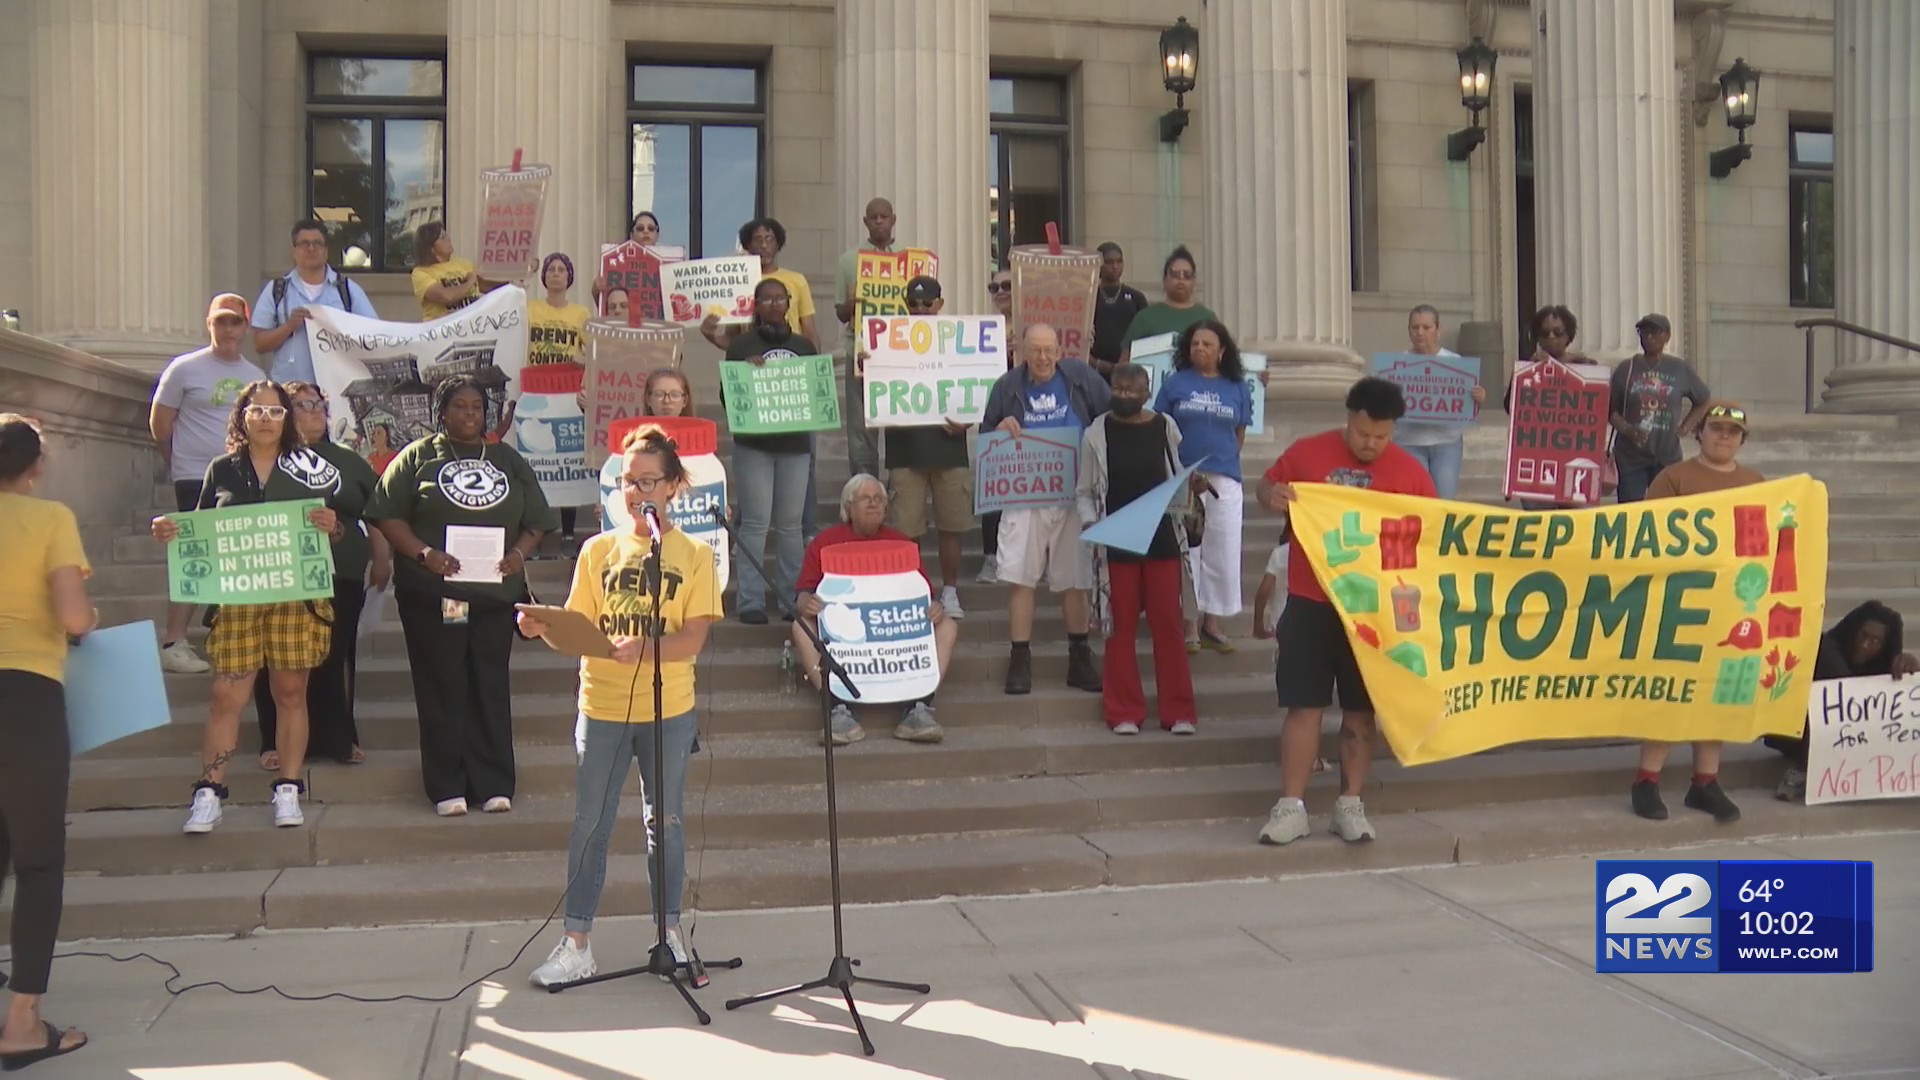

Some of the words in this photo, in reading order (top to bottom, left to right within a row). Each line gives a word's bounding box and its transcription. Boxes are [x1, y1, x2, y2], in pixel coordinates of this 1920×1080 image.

[488, 203, 535, 217] MASS
[484, 230, 532, 246] FAIR
[482, 248, 530, 263] RENT
[673, 264, 712, 278] WARM,
[715, 262, 749, 274] COZY,
[607, 271, 658, 289] REN
[674, 275, 749, 290] AFFORDABLE
[693, 288, 734, 300] HOMES
[862, 283, 908, 301] SUPPO
[1024, 296, 1084, 312] MASS
[440, 322, 468, 341] ONE
[470, 308, 520, 335] LEAVES
[531, 327, 577, 346] RENT
[868, 318, 998, 355] PEOPLE
[752, 367, 780, 380] KEEP
[783, 365, 807, 377] OUR
[918, 362, 944, 370] OVER
[599, 370, 648, 387] MAS
[754, 378, 808, 394] ELDERS
[597, 391, 635, 402] RUNS
[1406, 384, 1466, 396] NUESTRO
[757, 397, 769, 408] IN
[772, 393, 810, 406] THEIR
[1405, 396, 1464, 413] OGAR
[1519, 387, 1600, 411] RENT
[595, 405, 644, 425] FAI
[758, 407, 812, 424] HOMES
[1518, 409, 1530, 421] IS
[1537, 411, 1598, 426] WICKED
[558, 422, 585, 437] Sti
[559, 437, 585, 448] Toge
[1516, 427, 1597, 450] HIGH
[310, 466, 335, 485] NEIG
[535, 466, 597, 482] ndlor
[999, 461, 1065, 475] NUESTRO
[463, 471, 486, 491] 2
[984, 475, 1065, 498] HOGAR
[447, 483, 506, 506] NEIGHBOR
[215, 518, 252, 533] KEEP
[257, 513, 289, 528] OUR
[670, 513, 717, 527] gethe
[1438, 512, 1575, 558] KEEP
[1590, 507, 1719, 560] MASS
[217, 531, 291, 554] ELDERS
[219, 556, 237, 572] IN
[242, 551, 293, 570] THEIR
[220, 570, 294, 593] HOMES
[868, 604, 926, 625] Stick
[1438, 570, 1718, 672] HOME
[599, 613, 667, 637] CONTRL
[871, 622, 927, 637] Together
[878, 643, 929, 658] Corporate
[841, 654, 931, 675] andlords
[1491, 676, 1529, 704] THE
[1535, 673, 1599, 701] RENT
[1604, 674, 1697, 704] STABLE
[1882, 722, 1920, 742] Peo
[1869, 753, 1920, 794] Prof
